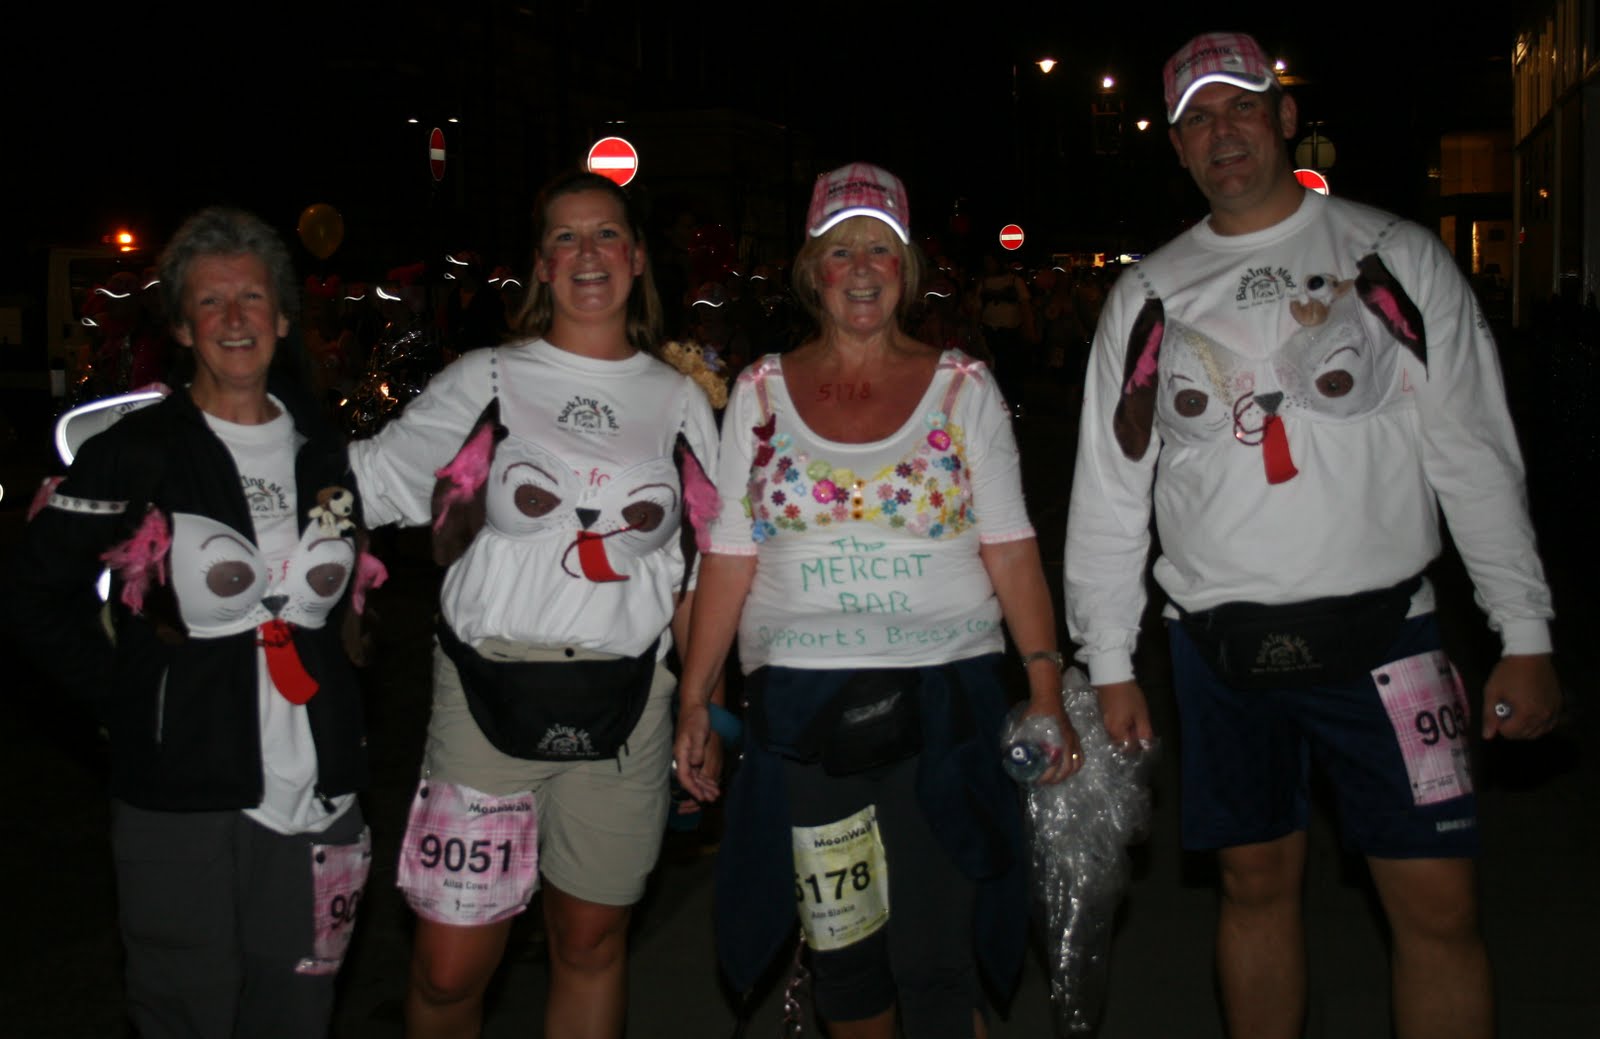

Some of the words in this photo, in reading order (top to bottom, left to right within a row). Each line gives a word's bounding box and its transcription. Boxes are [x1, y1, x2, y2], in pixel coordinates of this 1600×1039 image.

[816, 382, 871, 402] 5178
[801, 553, 932, 592] MERCAT
[838, 590, 912, 614] BAR
[420, 833, 513, 874] 9051
